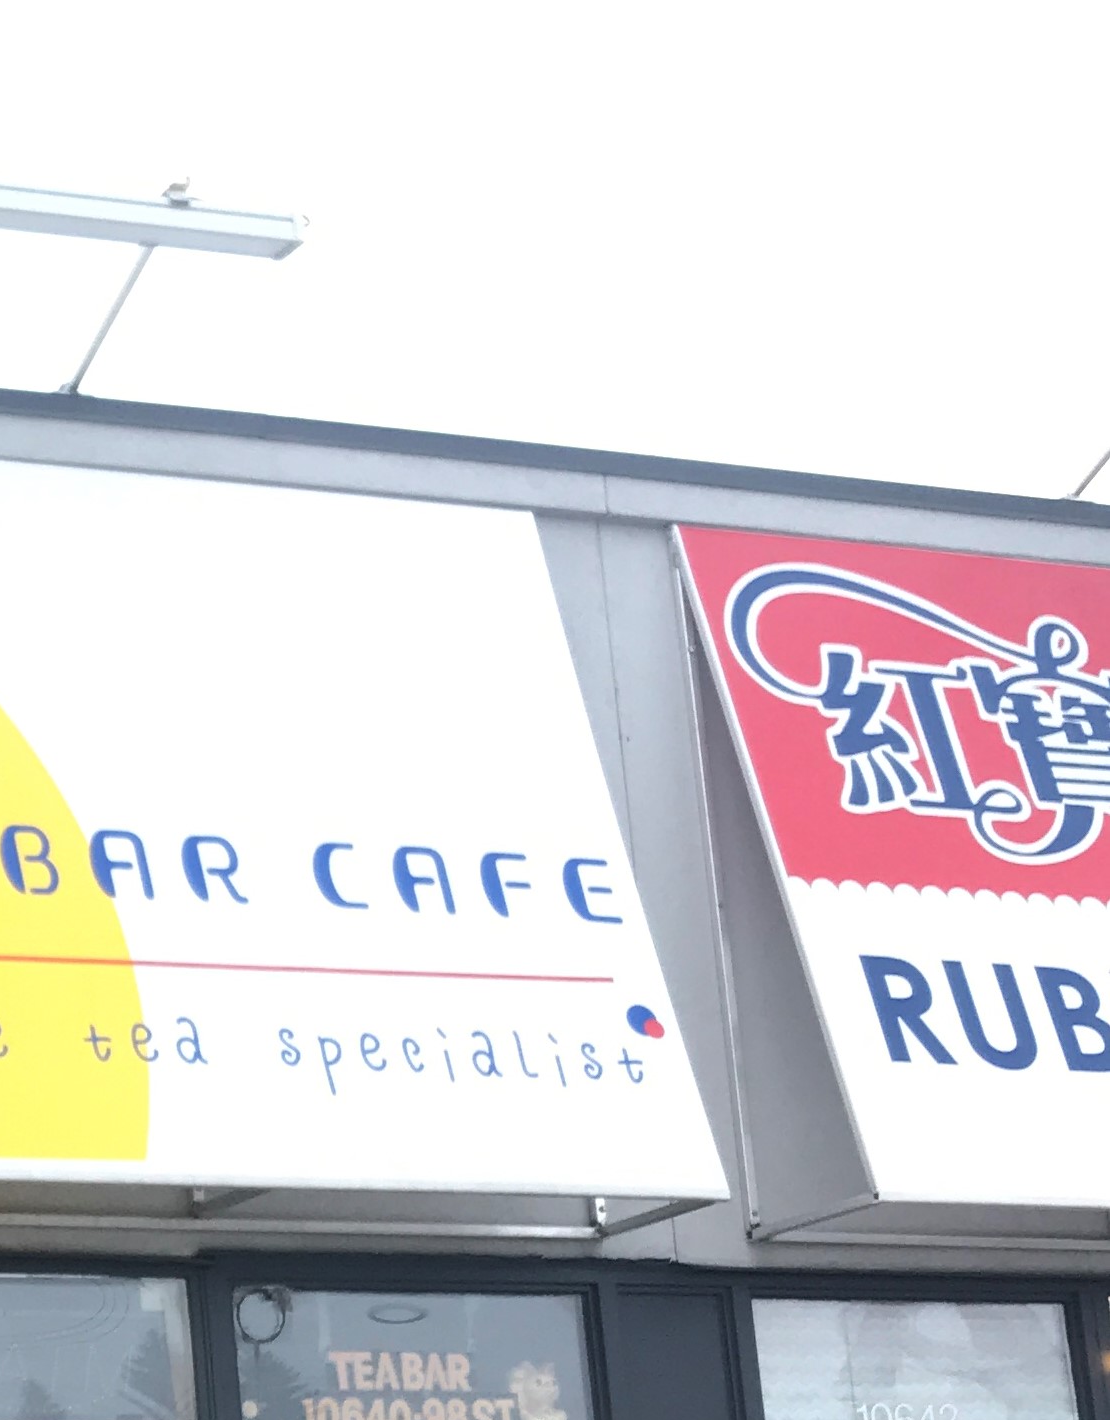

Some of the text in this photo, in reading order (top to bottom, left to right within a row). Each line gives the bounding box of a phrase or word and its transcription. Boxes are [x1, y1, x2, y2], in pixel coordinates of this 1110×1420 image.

[0, 824, 248, 904] BAR
[312, 842, 623, 924] CAFE
[85, 1017, 208, 1065] tea
[279, 1027, 646, 1096] specialist
